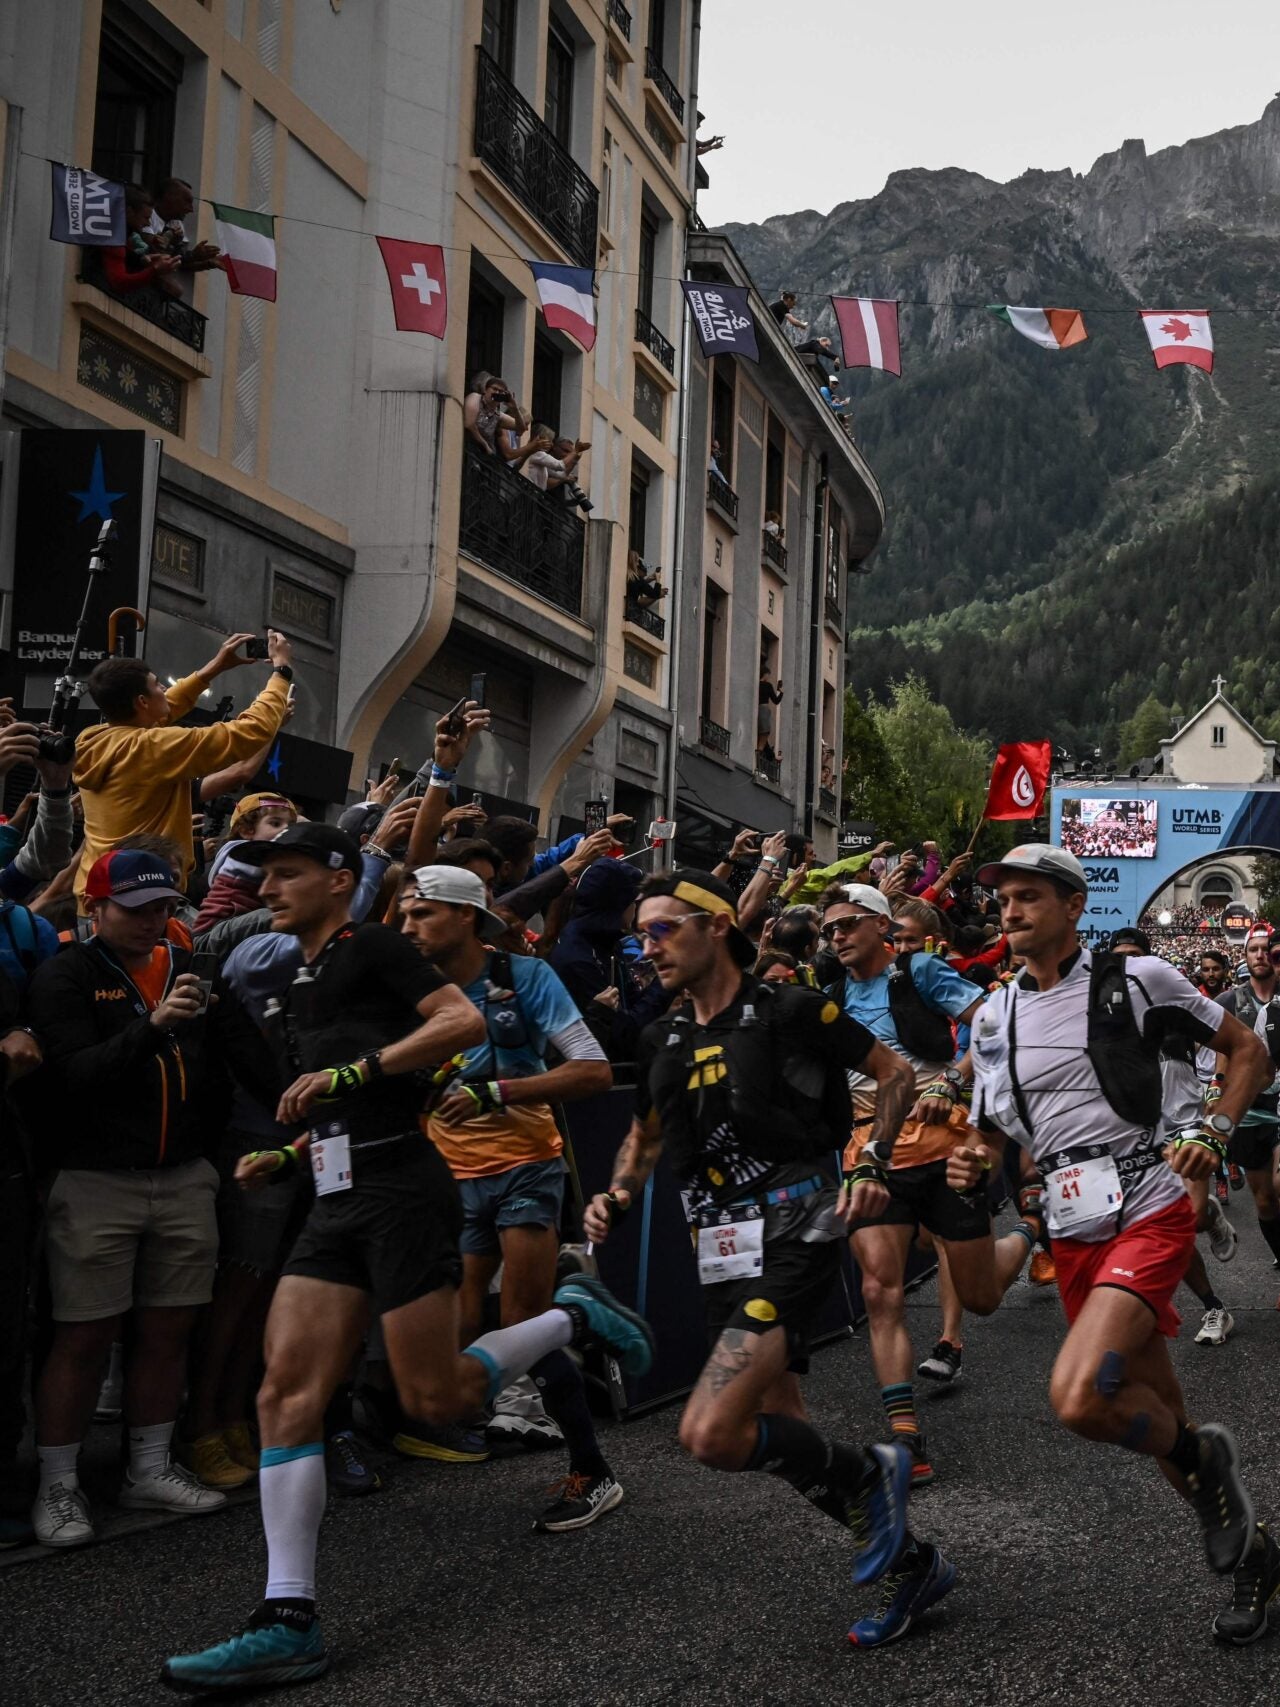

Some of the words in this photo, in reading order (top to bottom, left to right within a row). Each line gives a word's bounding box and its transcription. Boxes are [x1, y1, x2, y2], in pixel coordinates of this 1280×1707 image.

[273, 585, 329, 628] CHANGE
[1172, 808, 1222, 824] UTMB
[1174, 825, 1198, 833] WORLD
[1199, 826, 1220, 834] SERIES
[137, 872, 165, 882] UTMB
[1083, 866, 1120, 883] OKA
[1054, 1167, 1081, 1185] UTMB
[1061, 1180, 1081, 1201] 41
[718, 1239, 737, 1257] 61
